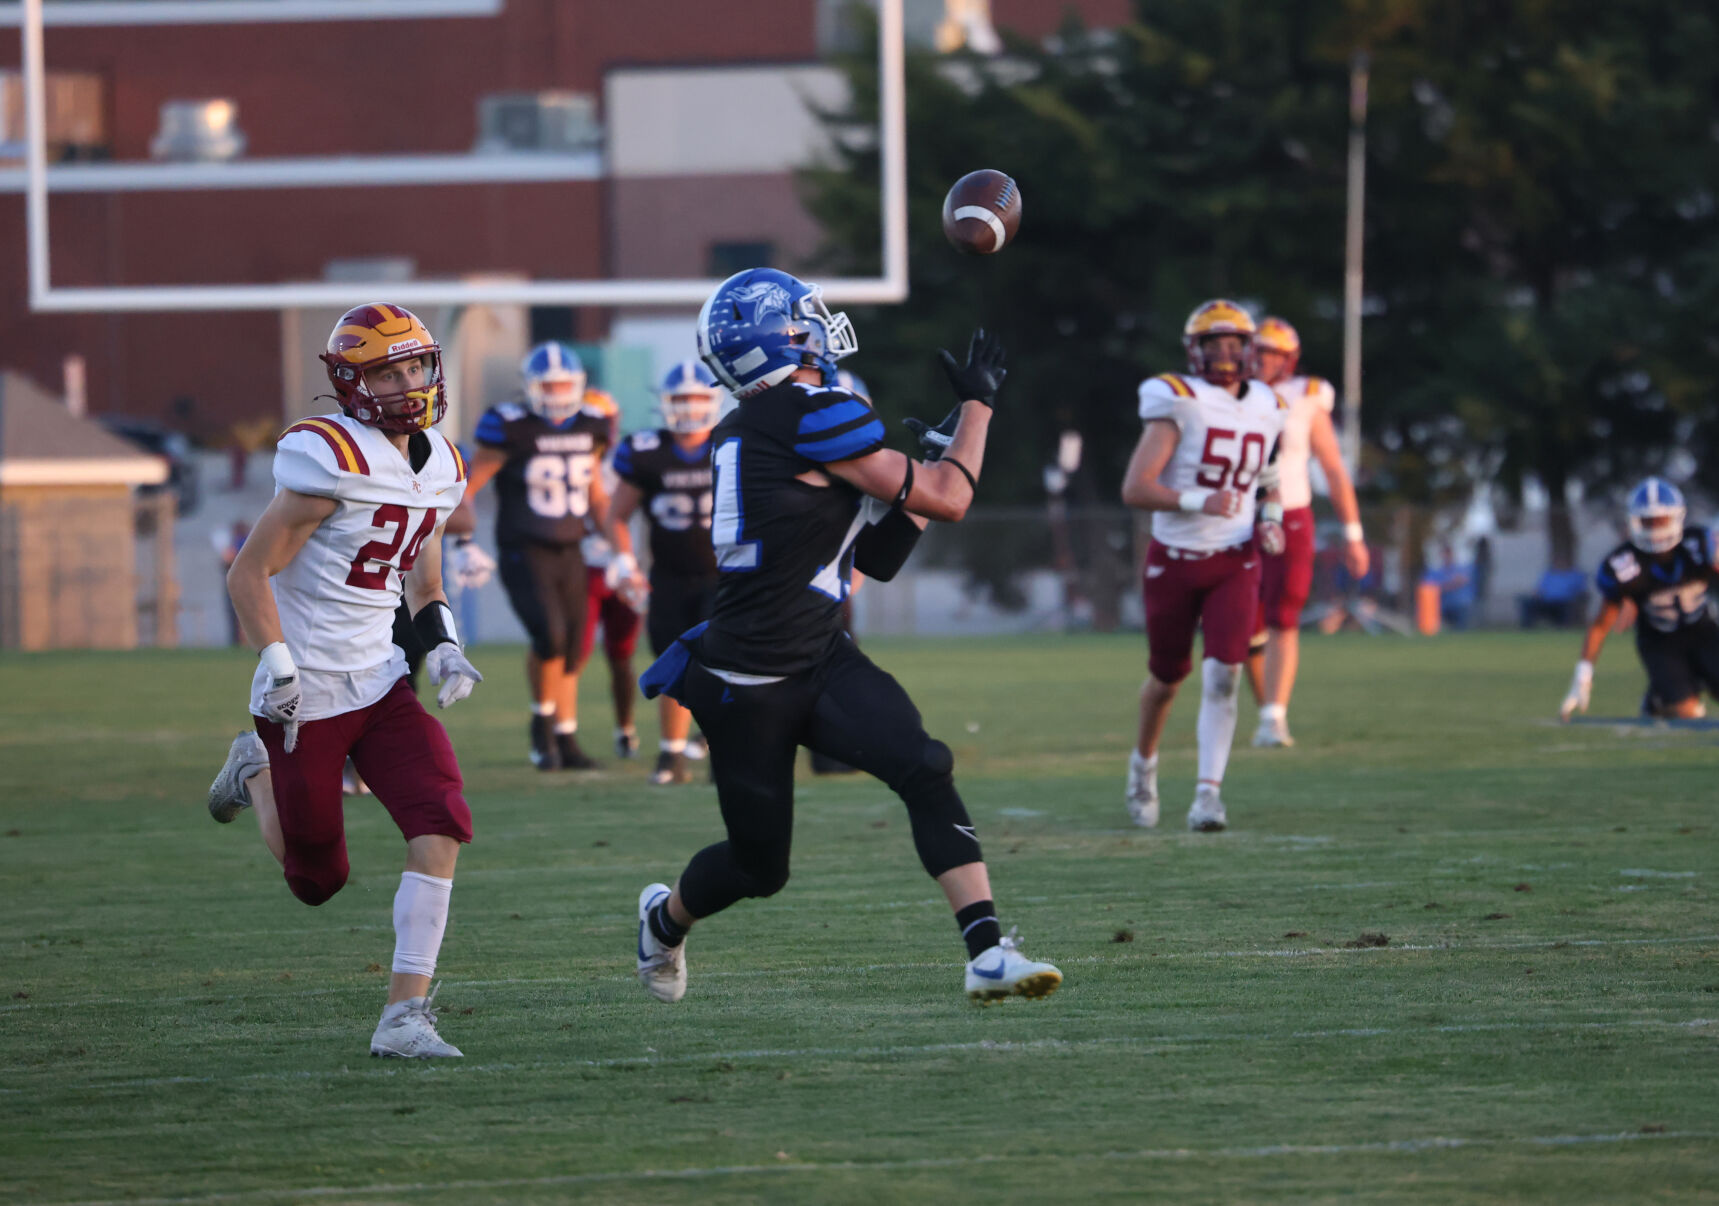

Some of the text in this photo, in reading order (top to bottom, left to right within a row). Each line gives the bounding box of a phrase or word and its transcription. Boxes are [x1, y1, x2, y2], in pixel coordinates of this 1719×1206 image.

[391, 339, 419, 352] Riddell
[1196, 427, 1265, 493] 50
[345, 503, 438, 591] 24
[277, 694, 300, 711] adidas
